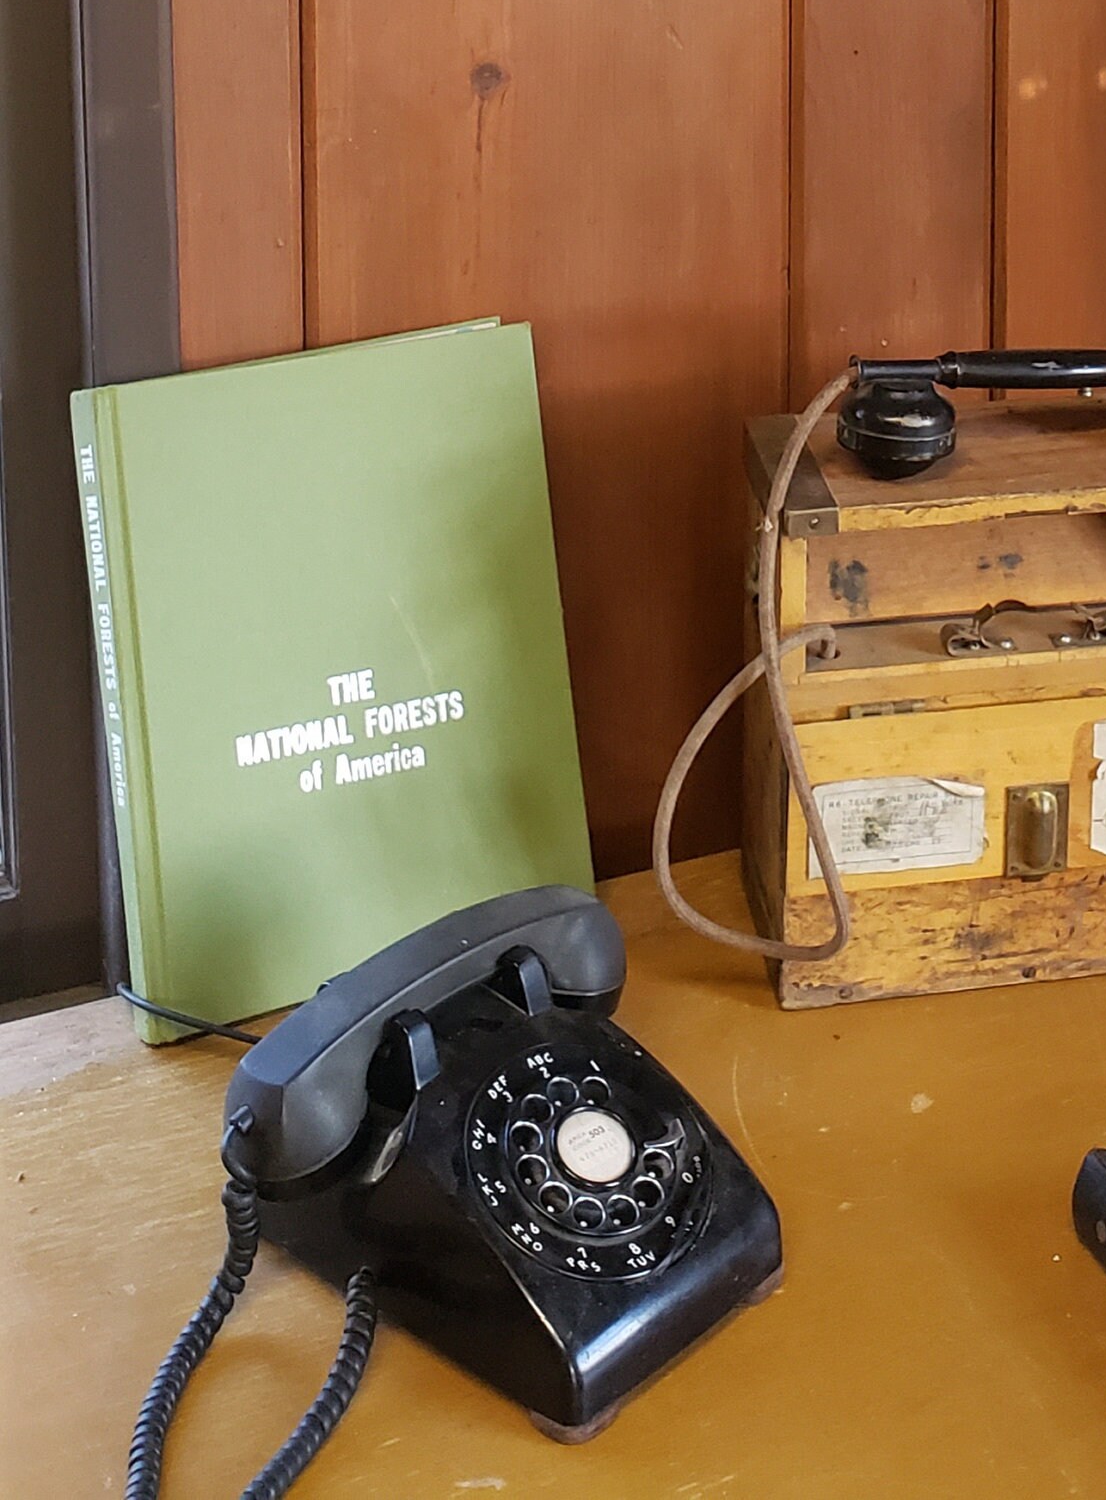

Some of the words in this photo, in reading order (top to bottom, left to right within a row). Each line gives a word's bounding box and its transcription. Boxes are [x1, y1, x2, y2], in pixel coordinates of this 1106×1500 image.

[79, 444, 96, 484] THE
[85, 495, 108, 592] NATIONAL
[98, 603, 116, 690] FORESTS
[327, 668, 376, 706] THE
[108, 701, 120, 720] of
[235, 714, 355, 767] NATIONAL
[364, 690, 464, 738] FORESTS
[299, 759, 322, 793] of
[335, 742, 426, 785] America
[526, 1052, 554, 1069] ABC
[589, 1059, 601, 1072] 1
[538, 1066, 551, 1079] 2
[487, 1075, 508, 1100] DEF
[502, 1091, 513, 1103] 3
[471, 1118, 486, 1151] GHI
[486, 1132, 497, 1144] 4
[494, 1180, 507, 1193] 5
[681, 1172, 694, 1184] 0
[528, 1221, 541, 1235] 6
[664, 1215, 677, 1228] 9
[511, 1222, 544, 1252] MNO
[576, 1246, 588, 1258] 7
[628, 1242, 642, 1255] 8
[565, 1256, 601, 1272] PRS
[626, 1249, 656, 1268] TUV
